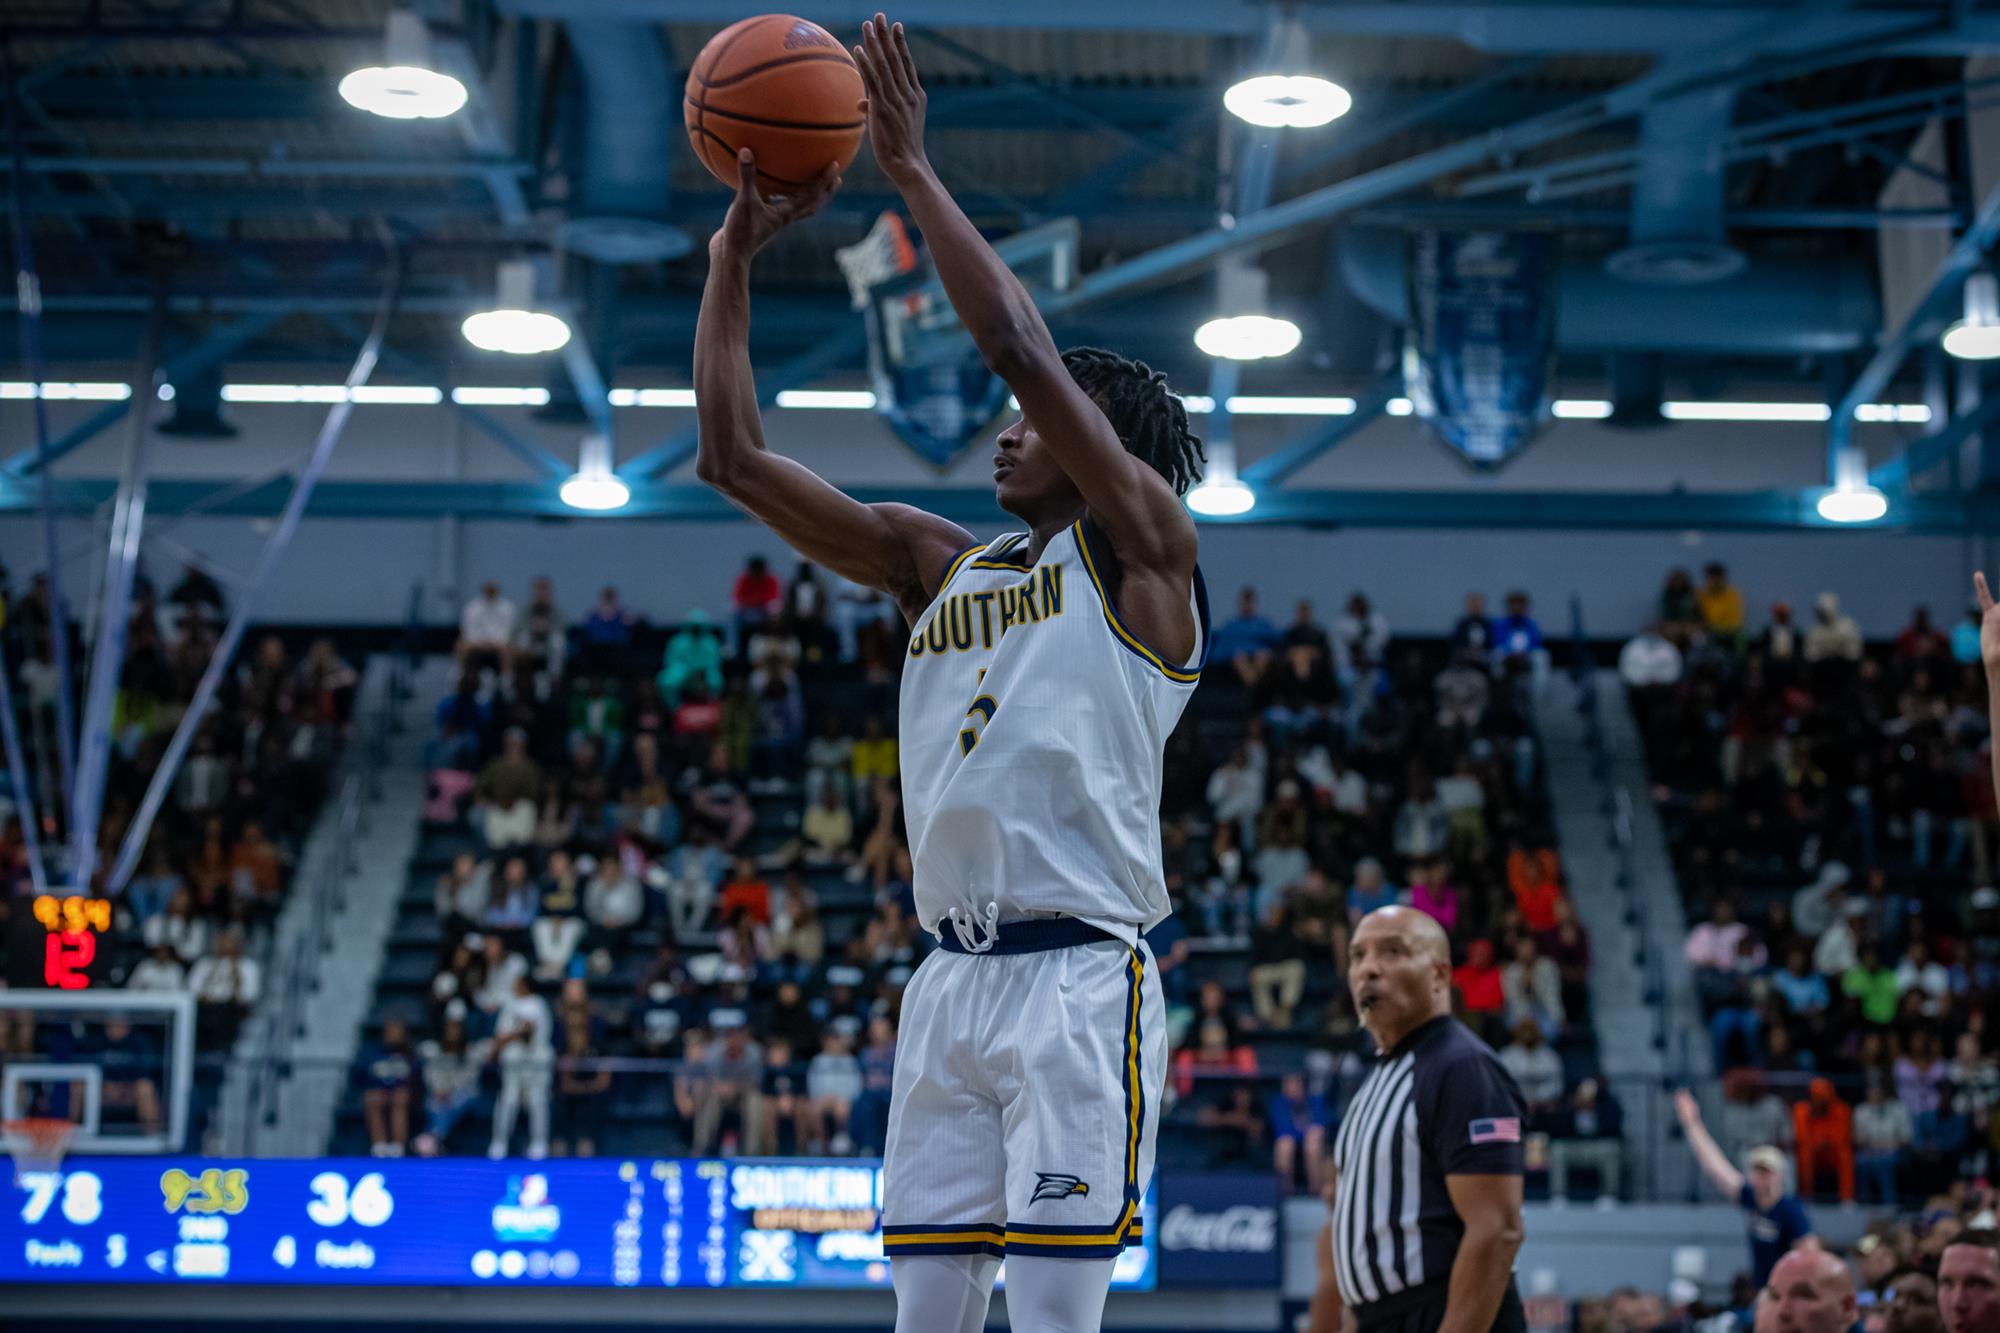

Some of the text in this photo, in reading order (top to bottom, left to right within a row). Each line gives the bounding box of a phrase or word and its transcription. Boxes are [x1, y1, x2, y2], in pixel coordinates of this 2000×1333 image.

[909, 564, 1063, 658] OUTHRN
[20, 1171, 102, 1225] 78
[306, 1171, 394, 1227] 36
